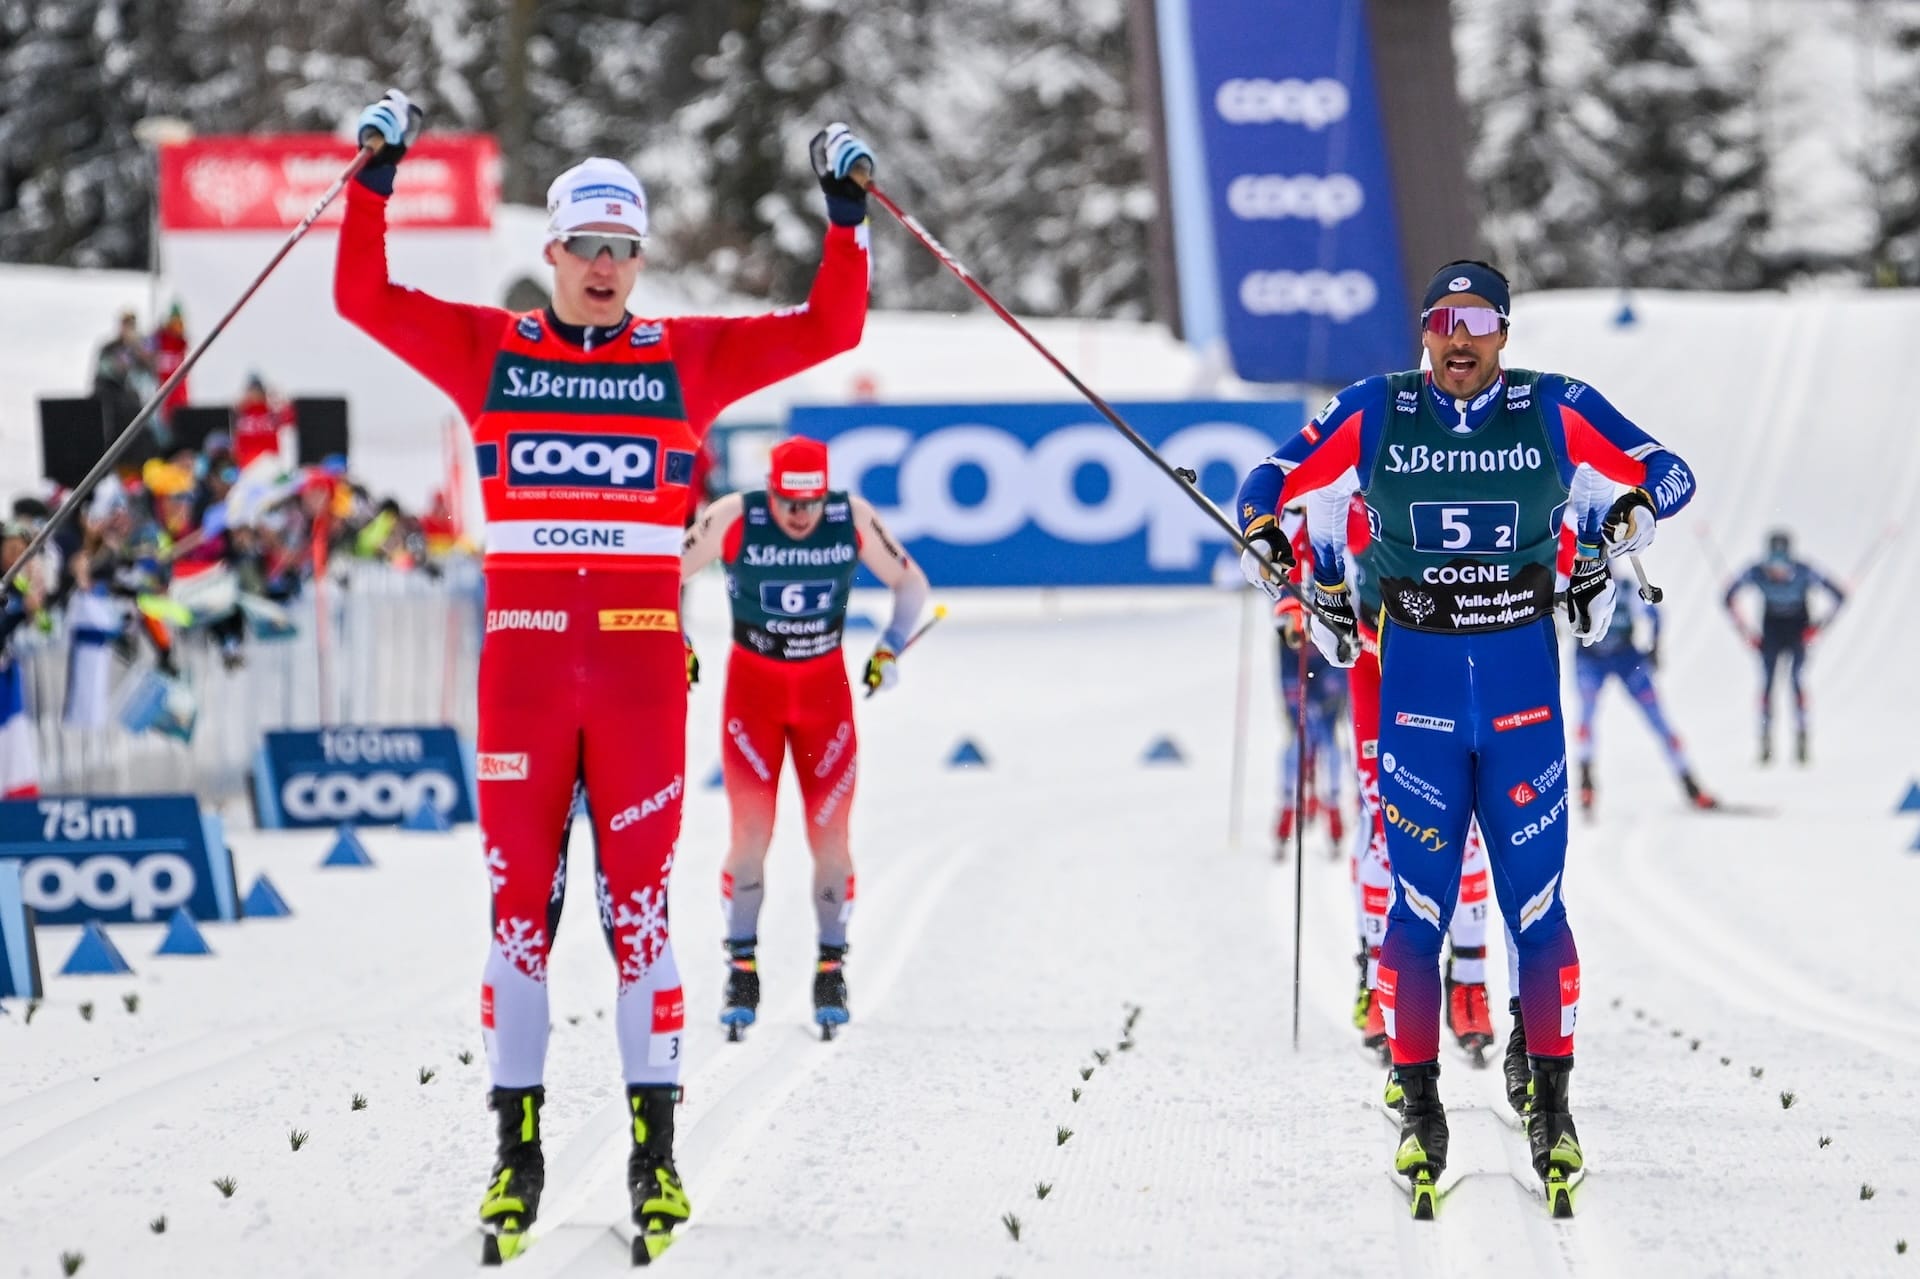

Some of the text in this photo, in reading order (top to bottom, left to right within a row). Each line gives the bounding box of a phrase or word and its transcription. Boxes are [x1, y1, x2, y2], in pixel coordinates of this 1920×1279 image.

[1216, 78, 1348, 131] coop
[1227, 174, 1364, 227] coop
[1240, 270, 1377, 323] coop
[503, 366, 665, 401] S.Bernardo
[511, 440, 651, 485] coop
[1384, 442, 1541, 473] S.Bernardo
[826, 422, 1286, 570] coop
[533, 528, 624, 547] COGNE
[1441, 508, 1511, 549] 5 2
[744, 541, 853, 566] S.Bernardo
[1423, 564, 1509, 584] COGNE
[780, 583, 804, 613] 6
[1454, 592, 1491, 609] Valle
[613, 614, 667, 626] DHL
[766, 618, 825, 635] COGNE
[1450, 611, 1495, 628] Vallée
[321, 729, 424, 763] 100m
[281, 770, 458, 822] coop
[610, 780, 676, 831] CRAFT
[38, 800, 135, 840] 75m
[1511, 795, 1565, 846] CRAFT
[22, 854, 195, 918] oop
[670, 1037, 679, 1060] 3
